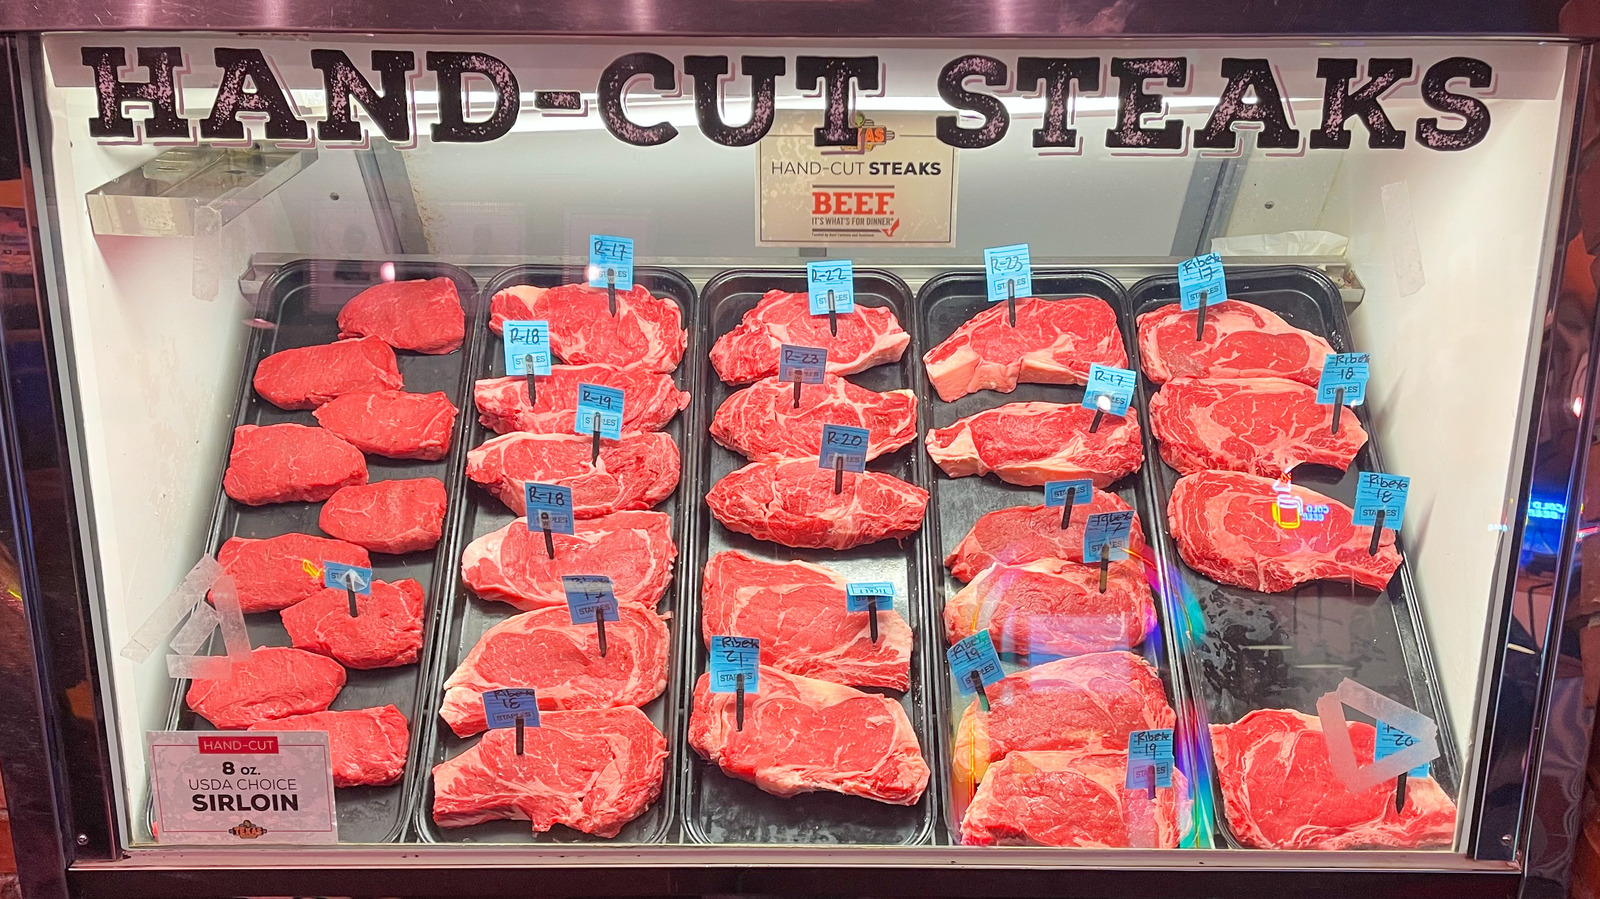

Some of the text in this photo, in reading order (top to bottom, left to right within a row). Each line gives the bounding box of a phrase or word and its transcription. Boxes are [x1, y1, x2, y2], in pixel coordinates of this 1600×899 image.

[81, 47, 1493, 151] HAND-CUT STEAKS
[771, 162, 941, 175] HAND-CUT STEAKS
[812, 192, 894, 215] BEEF.
[812, 217, 824, 226] IT'S
[825, 217, 850, 226] WHAT'S
[851, 217, 865, 226] FOR
[594, 240, 627, 261] R-17
[990, 255, 1024, 275] R-23
[812, 267, 847, 283] R-22
[509, 327, 540, 345] R-18
[785, 350, 819, 364] R-23
[1094, 370, 1124, 386] R-17
[1340, 367, 1354, 380] 18
[583, 389, 612, 410] R-19
[827, 431, 863, 447] R-20
[529, 486, 565, 506] R-18
[1376, 489, 1395, 503] 18
[722, 650, 743, 668] 21
[965, 647, 982, 662] 19
[203, 740, 274, 751] HAND-CUT
[1144, 742, 1157, 760] 19
[222, 761, 235, 775] 8
[188, 778, 297, 790] USDA CHOICE
[192, 793, 299, 812] SIRLOIN
[234, 826, 263, 836] TEXAS
